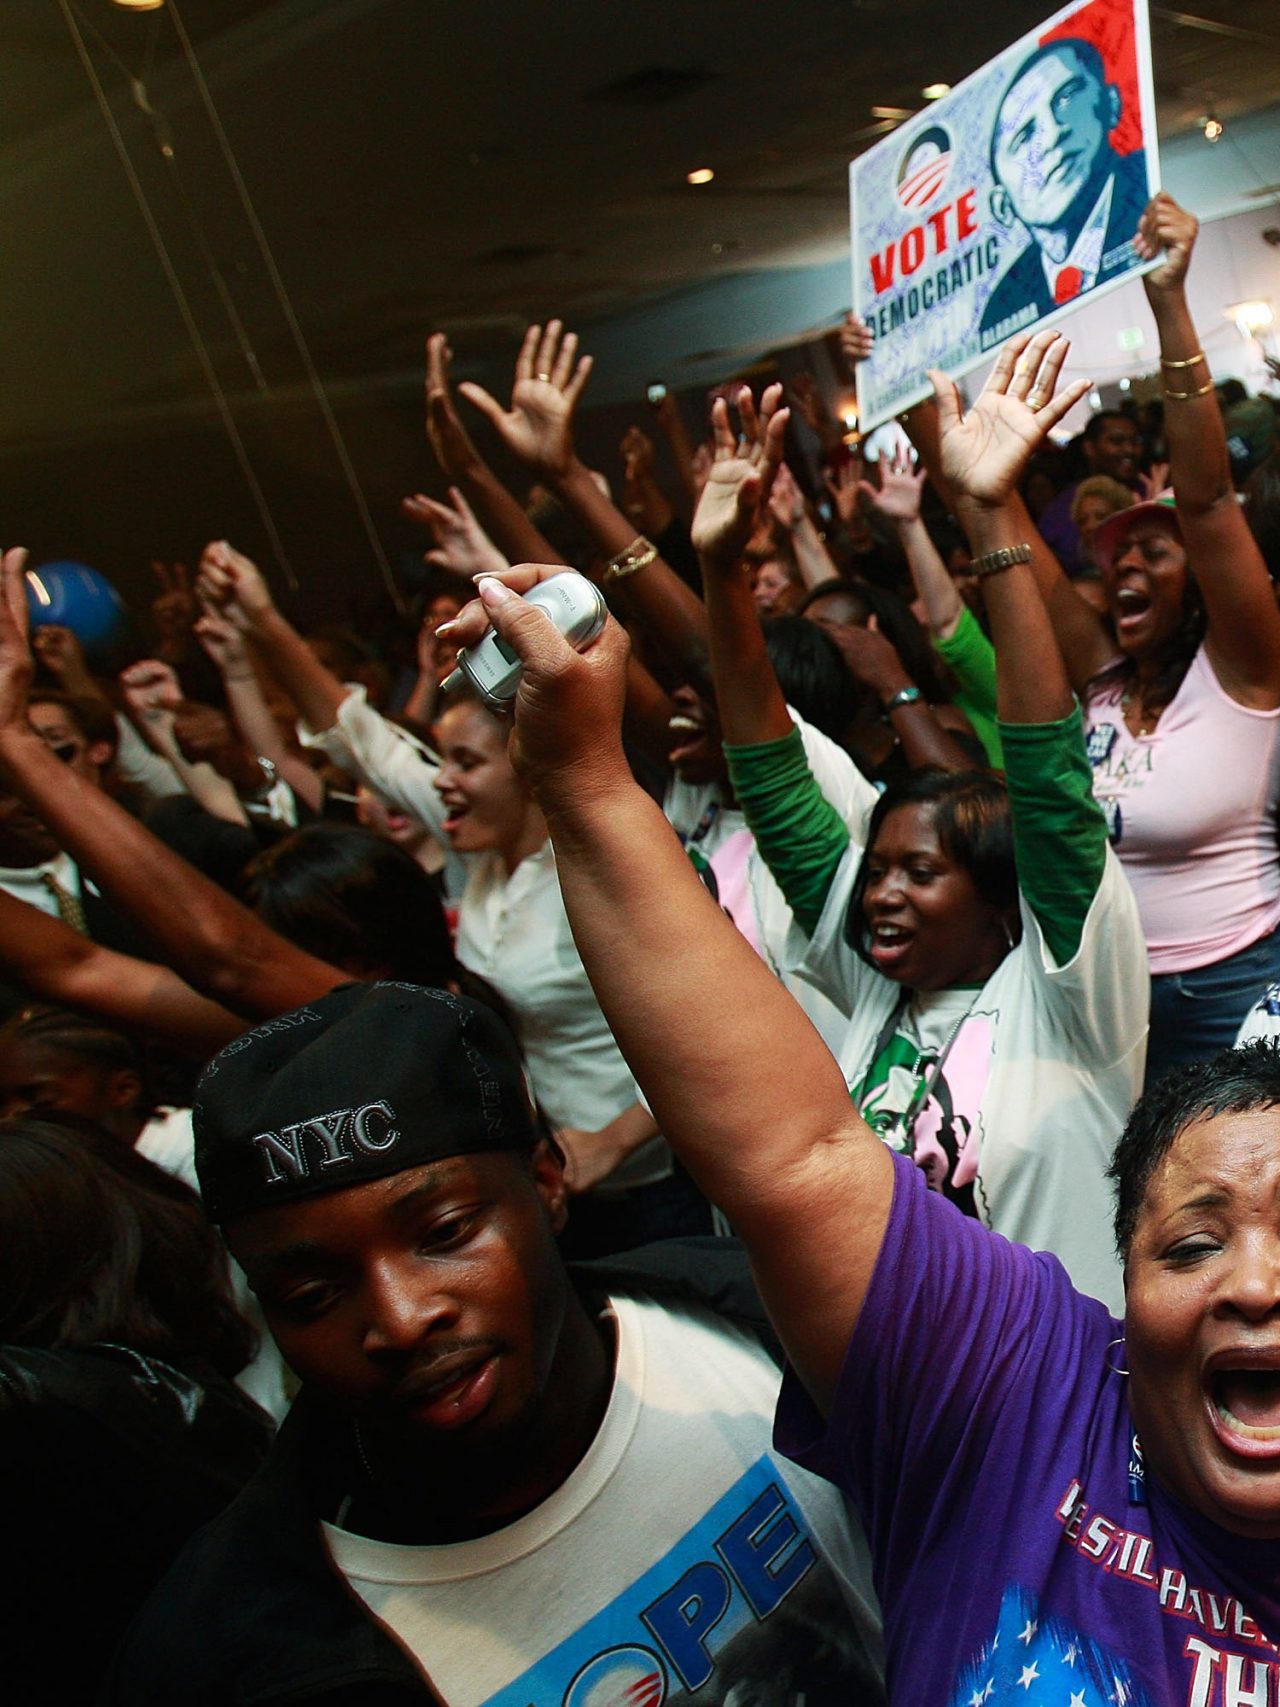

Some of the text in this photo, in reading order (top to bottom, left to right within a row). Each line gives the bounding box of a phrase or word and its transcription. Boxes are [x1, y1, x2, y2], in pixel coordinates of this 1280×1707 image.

[866, 235, 1000, 341] DEMOCRATIC
[868, 188, 977, 295] VOTE
[252, 1099, 401, 1184] NYC
[522, 1482, 818, 1707] OPE
